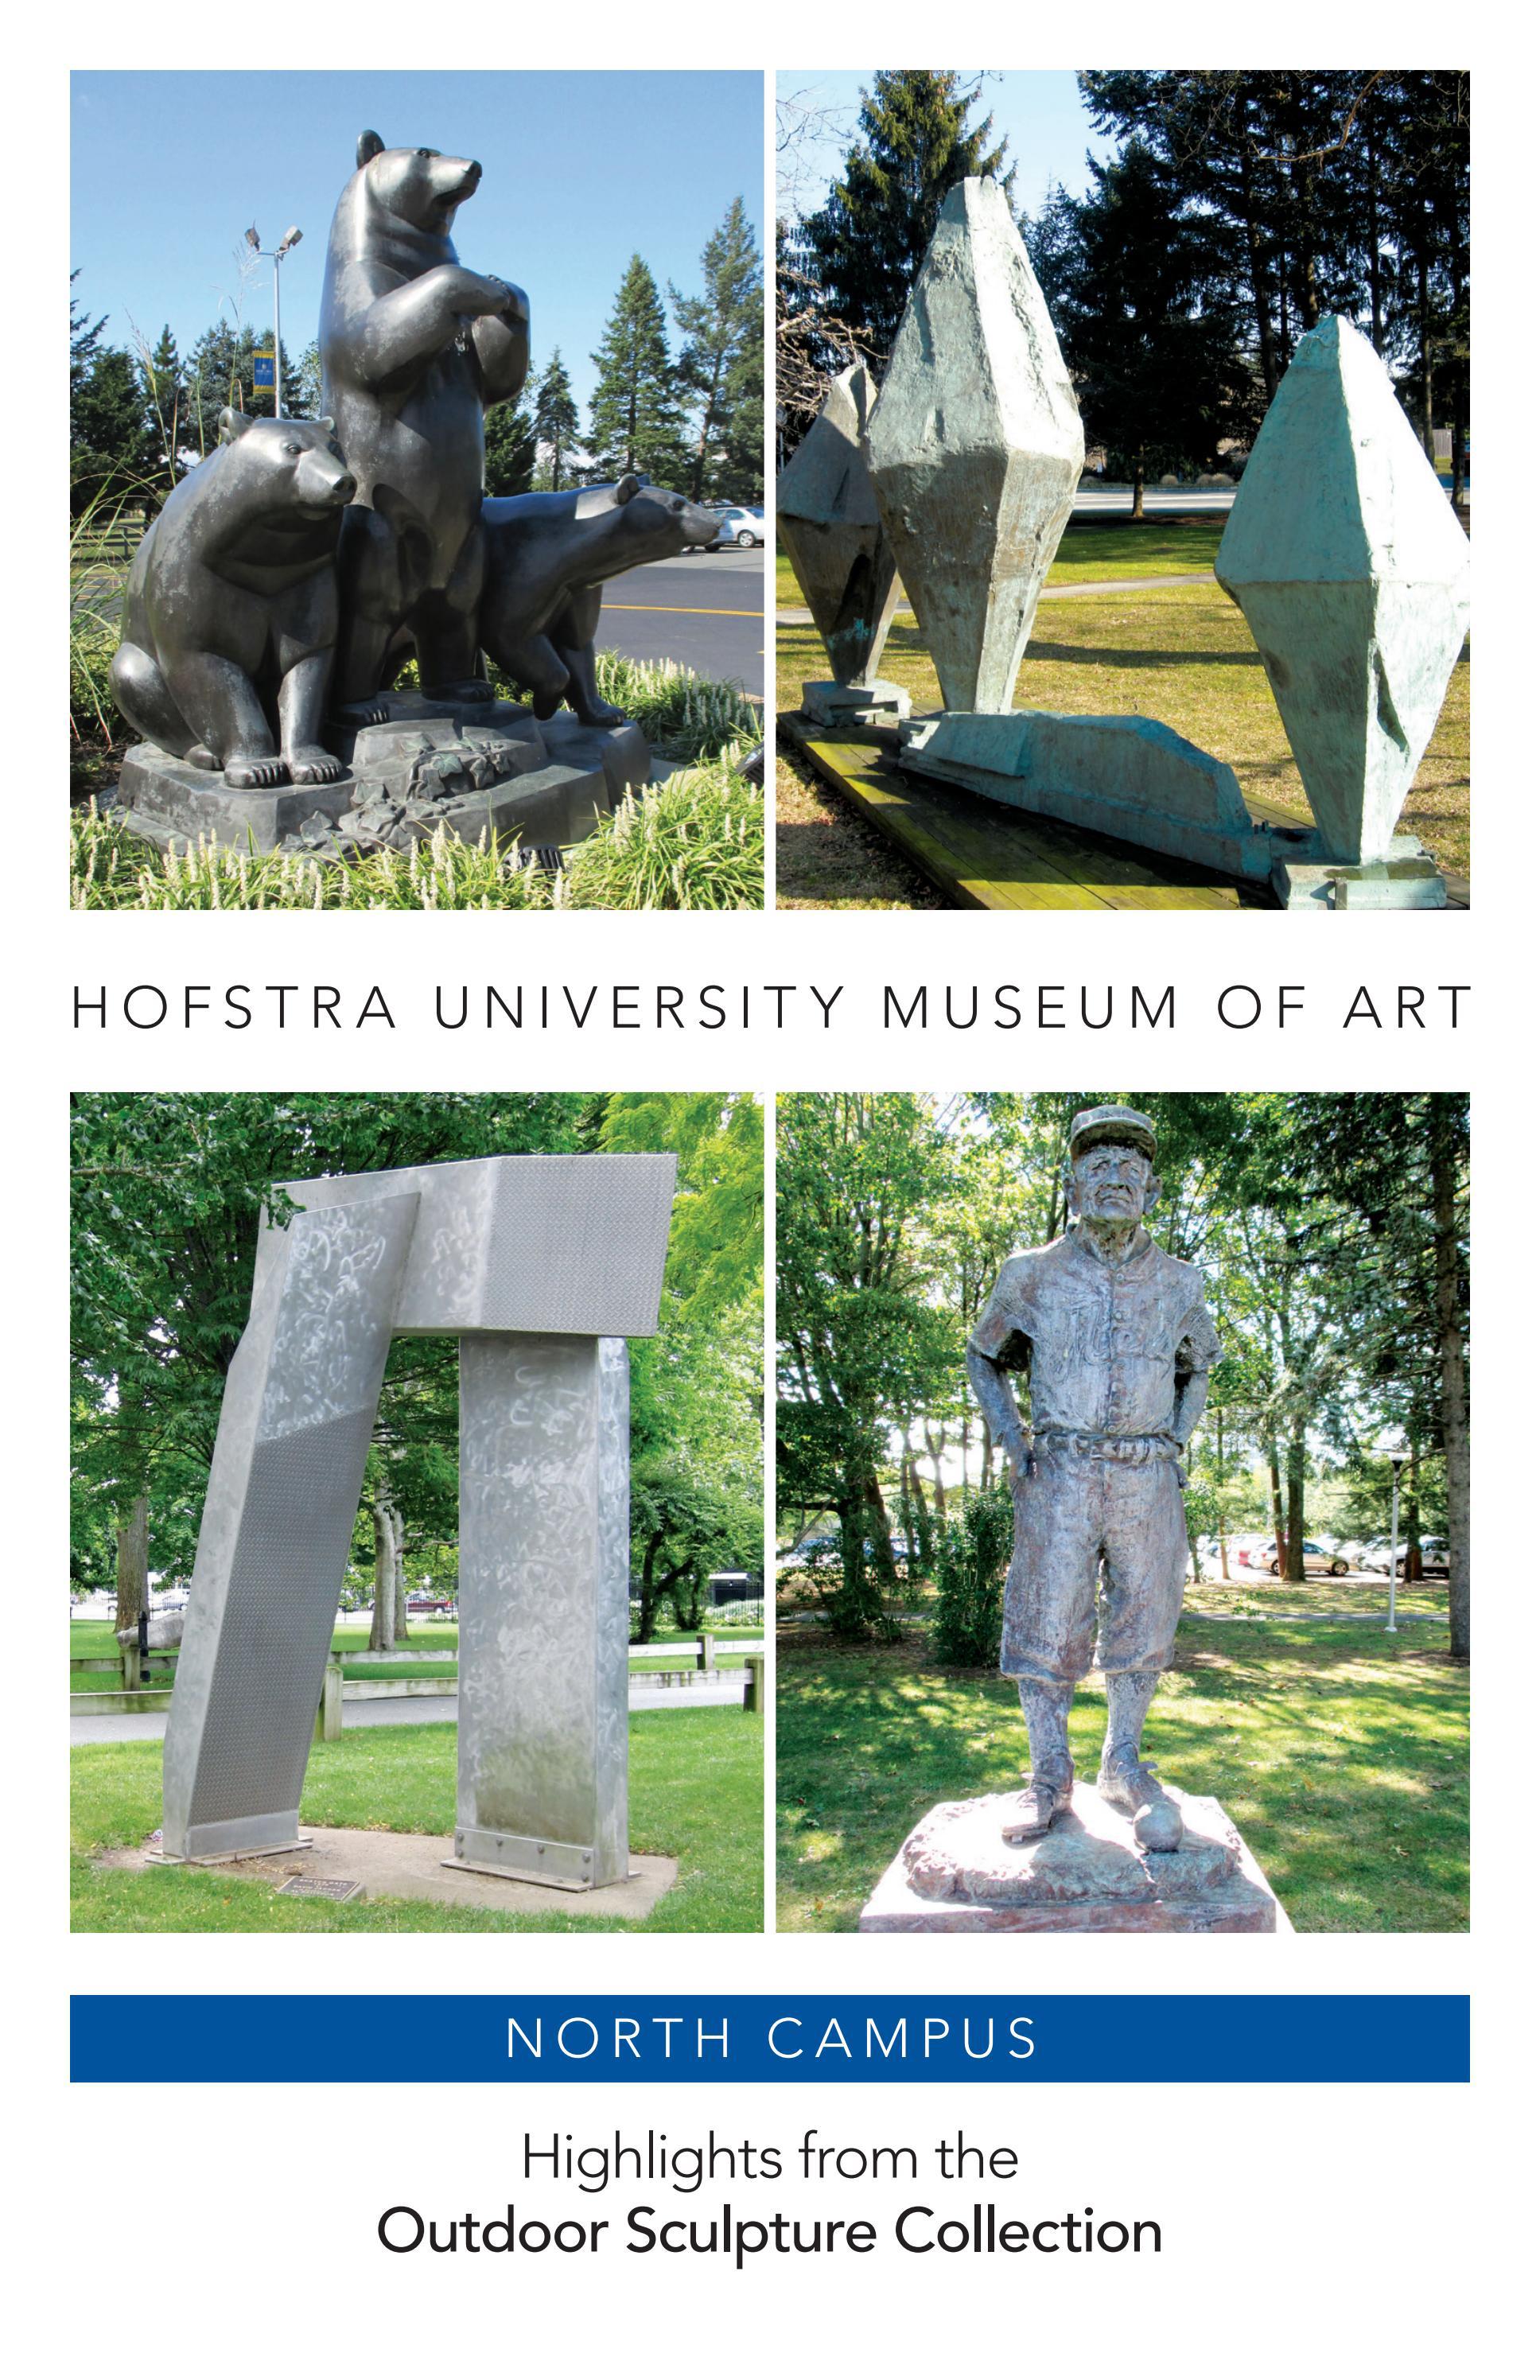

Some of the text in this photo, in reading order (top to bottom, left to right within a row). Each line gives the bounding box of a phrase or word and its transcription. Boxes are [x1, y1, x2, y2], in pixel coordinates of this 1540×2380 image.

[74, 985, 1472, 1029] HOFSTRA UNIVERSITY MUSEUM OF ART
[508, 2016, 1035, 2059] NORTH CAMPUS
[524, 2129, 1018, 2193] Highlights from the
[377, 2203, 1161, 2270] Outdoor Sculpture Collection
